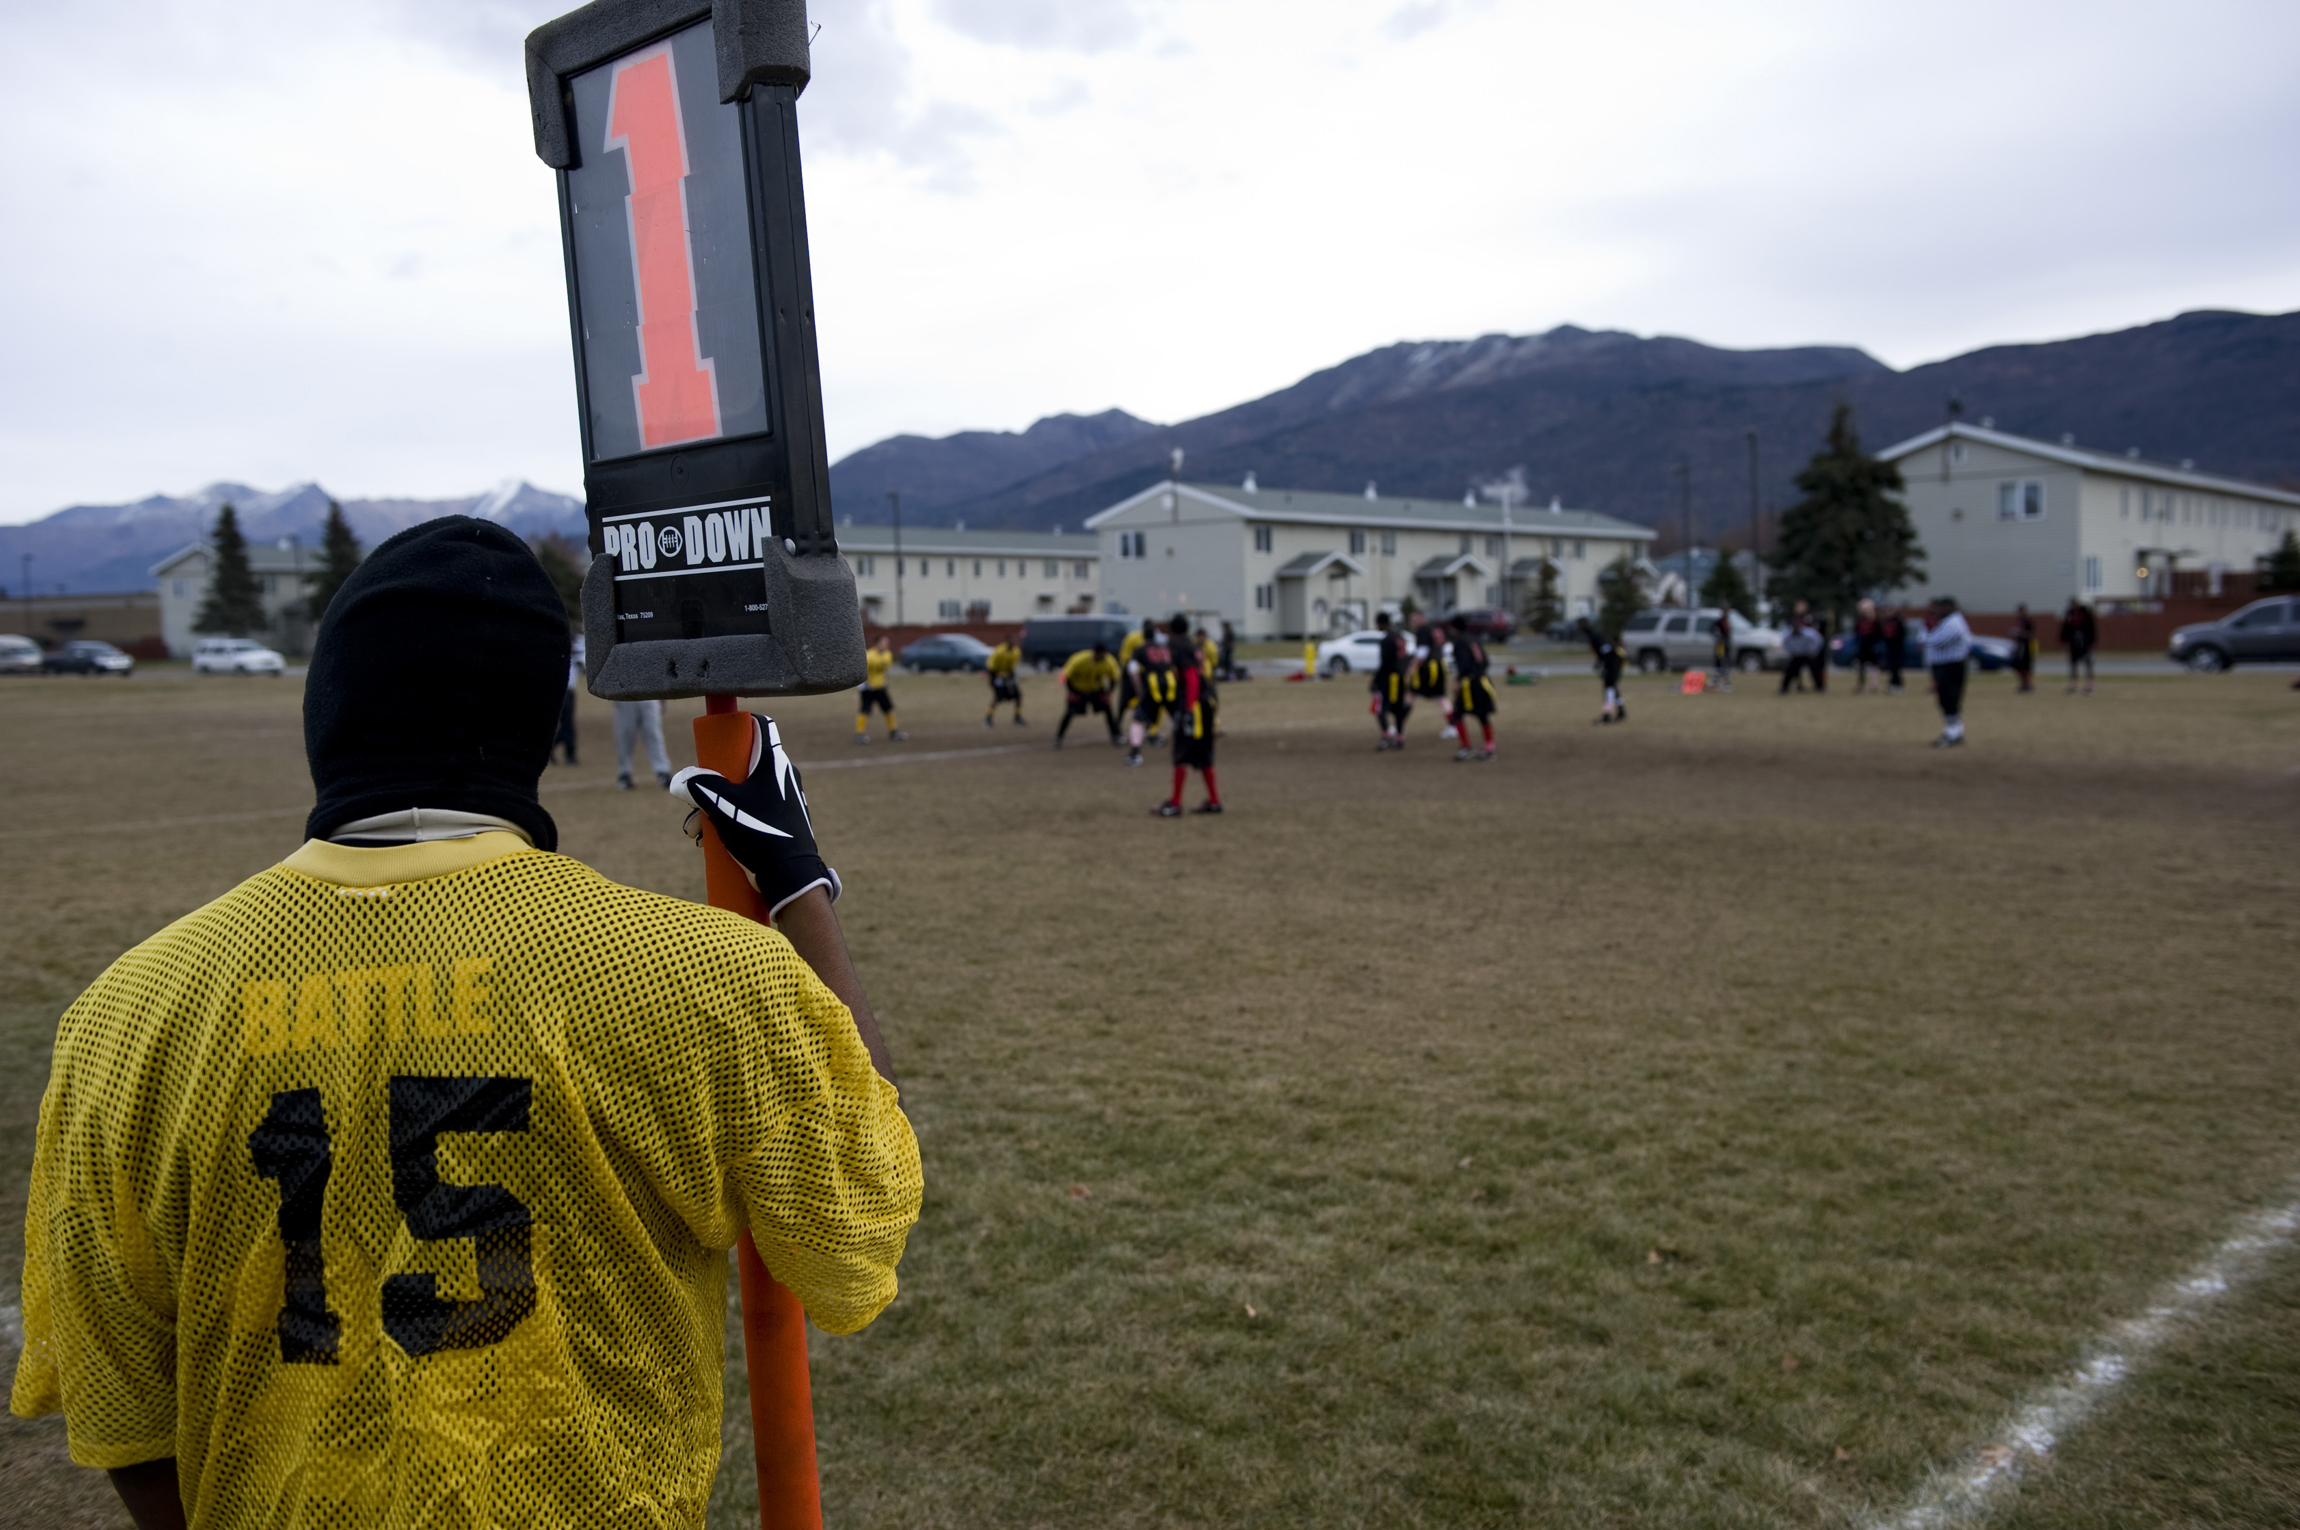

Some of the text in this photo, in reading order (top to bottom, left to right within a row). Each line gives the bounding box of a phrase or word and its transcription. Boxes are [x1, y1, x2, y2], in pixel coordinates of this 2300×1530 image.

[603, 41, 721, 450] 1
[603, 506, 772, 571] PRO DOWN
[744, 603, 768, 612] 1-800-527
[249, 1076, 536, 1365] 15
